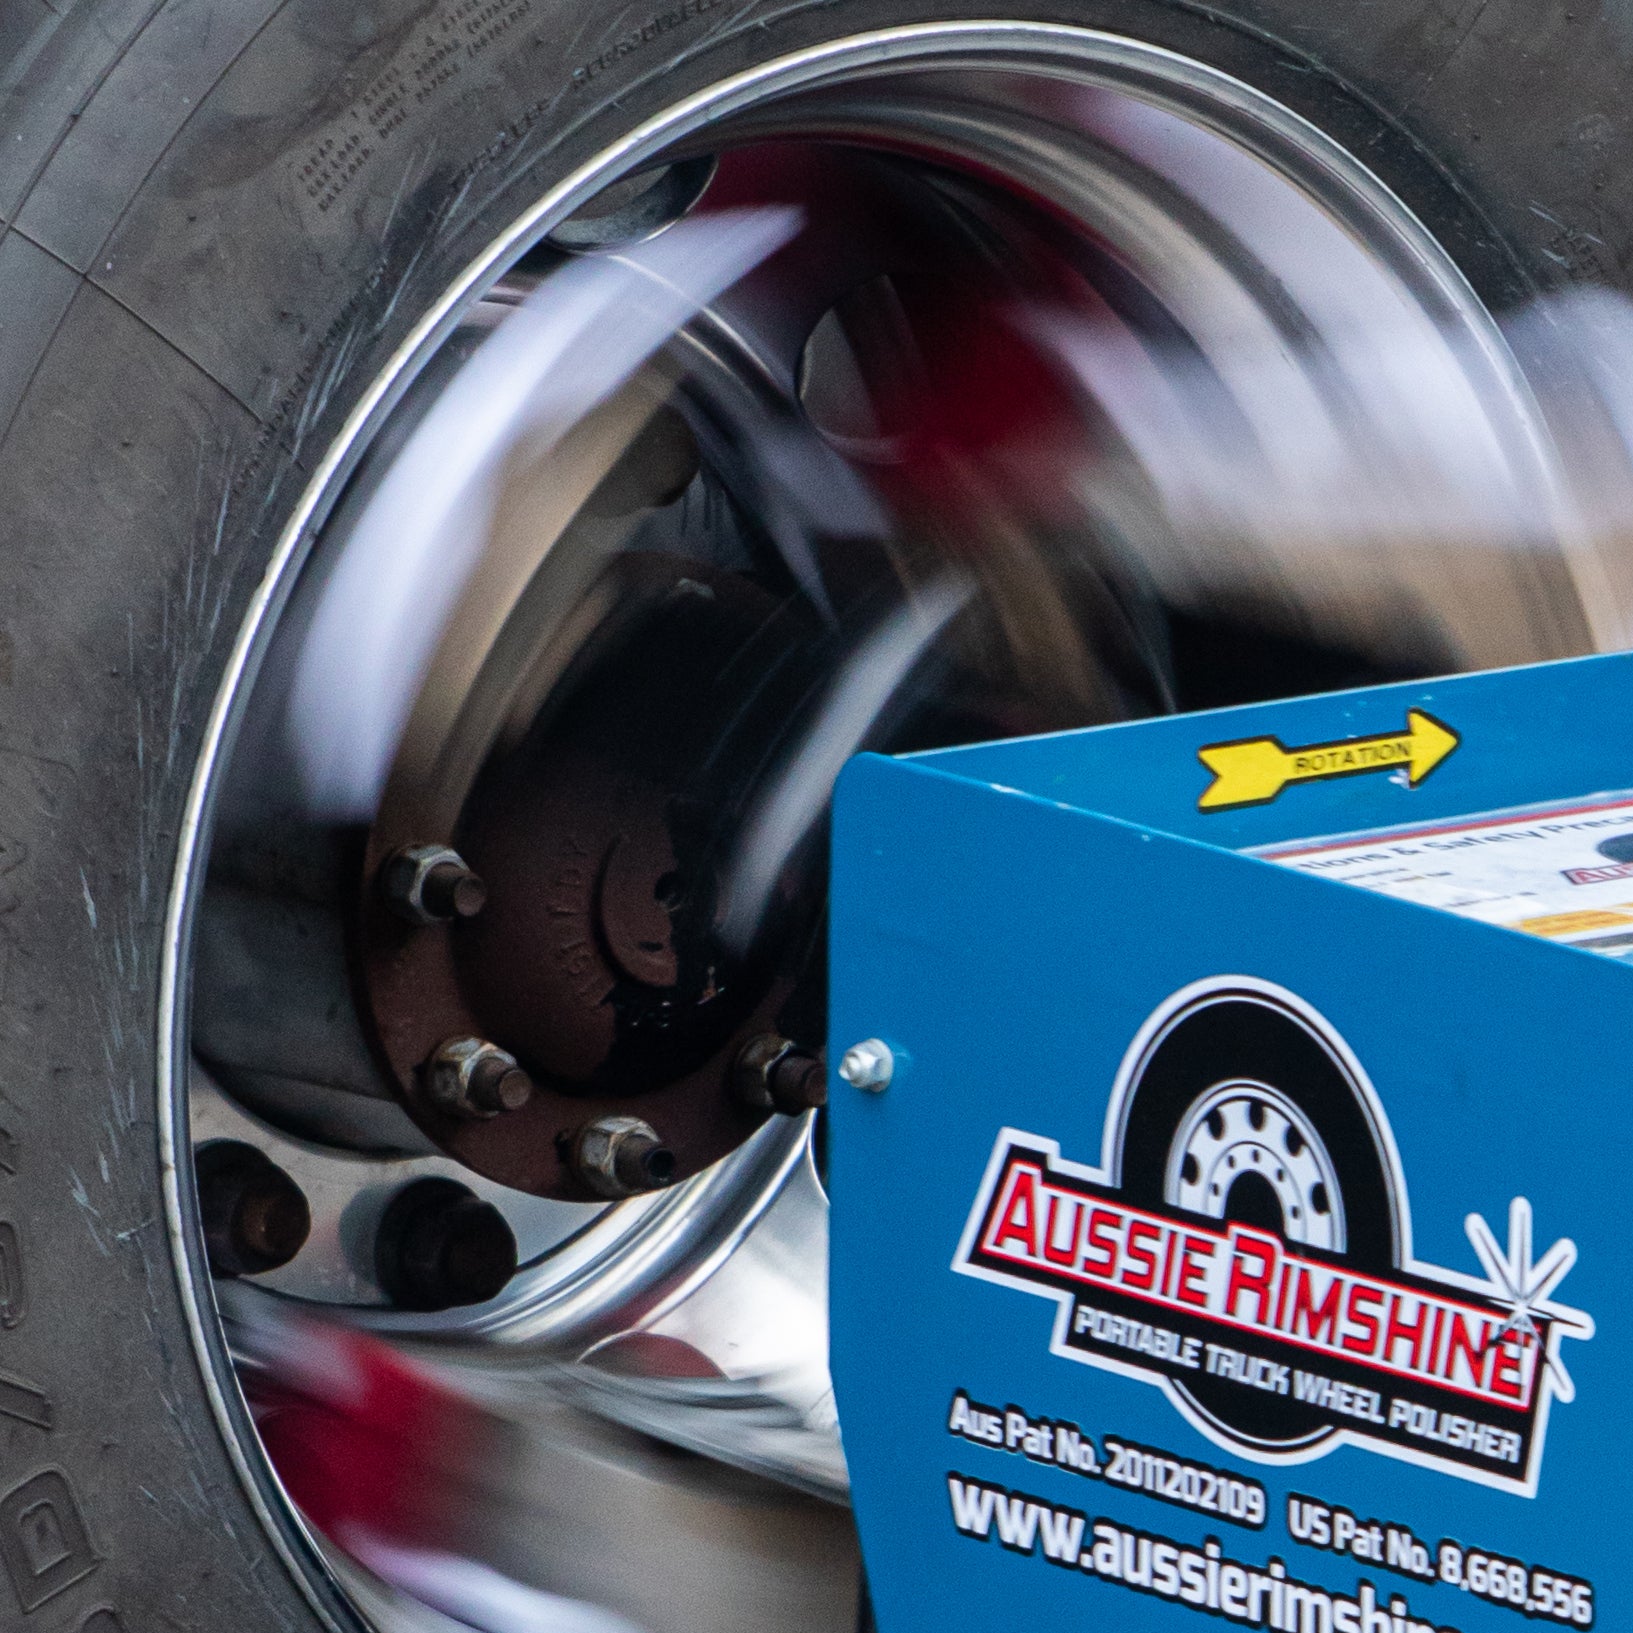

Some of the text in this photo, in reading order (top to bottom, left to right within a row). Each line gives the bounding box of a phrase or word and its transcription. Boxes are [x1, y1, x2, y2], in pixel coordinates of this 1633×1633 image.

[1294, 740, 1413, 774] ROTATION
[1424, 826, 1544, 851] Safety
[988, 1168, 1531, 1399] AUSSIE RIMSHINE
[1073, 1303, 1523, 1464] PORTABLE TRUCK WHEEL POLISHER
[949, 1395, 1593, 1625] Aus Pat No. 2011202109 US Pat No. 8,668,556
